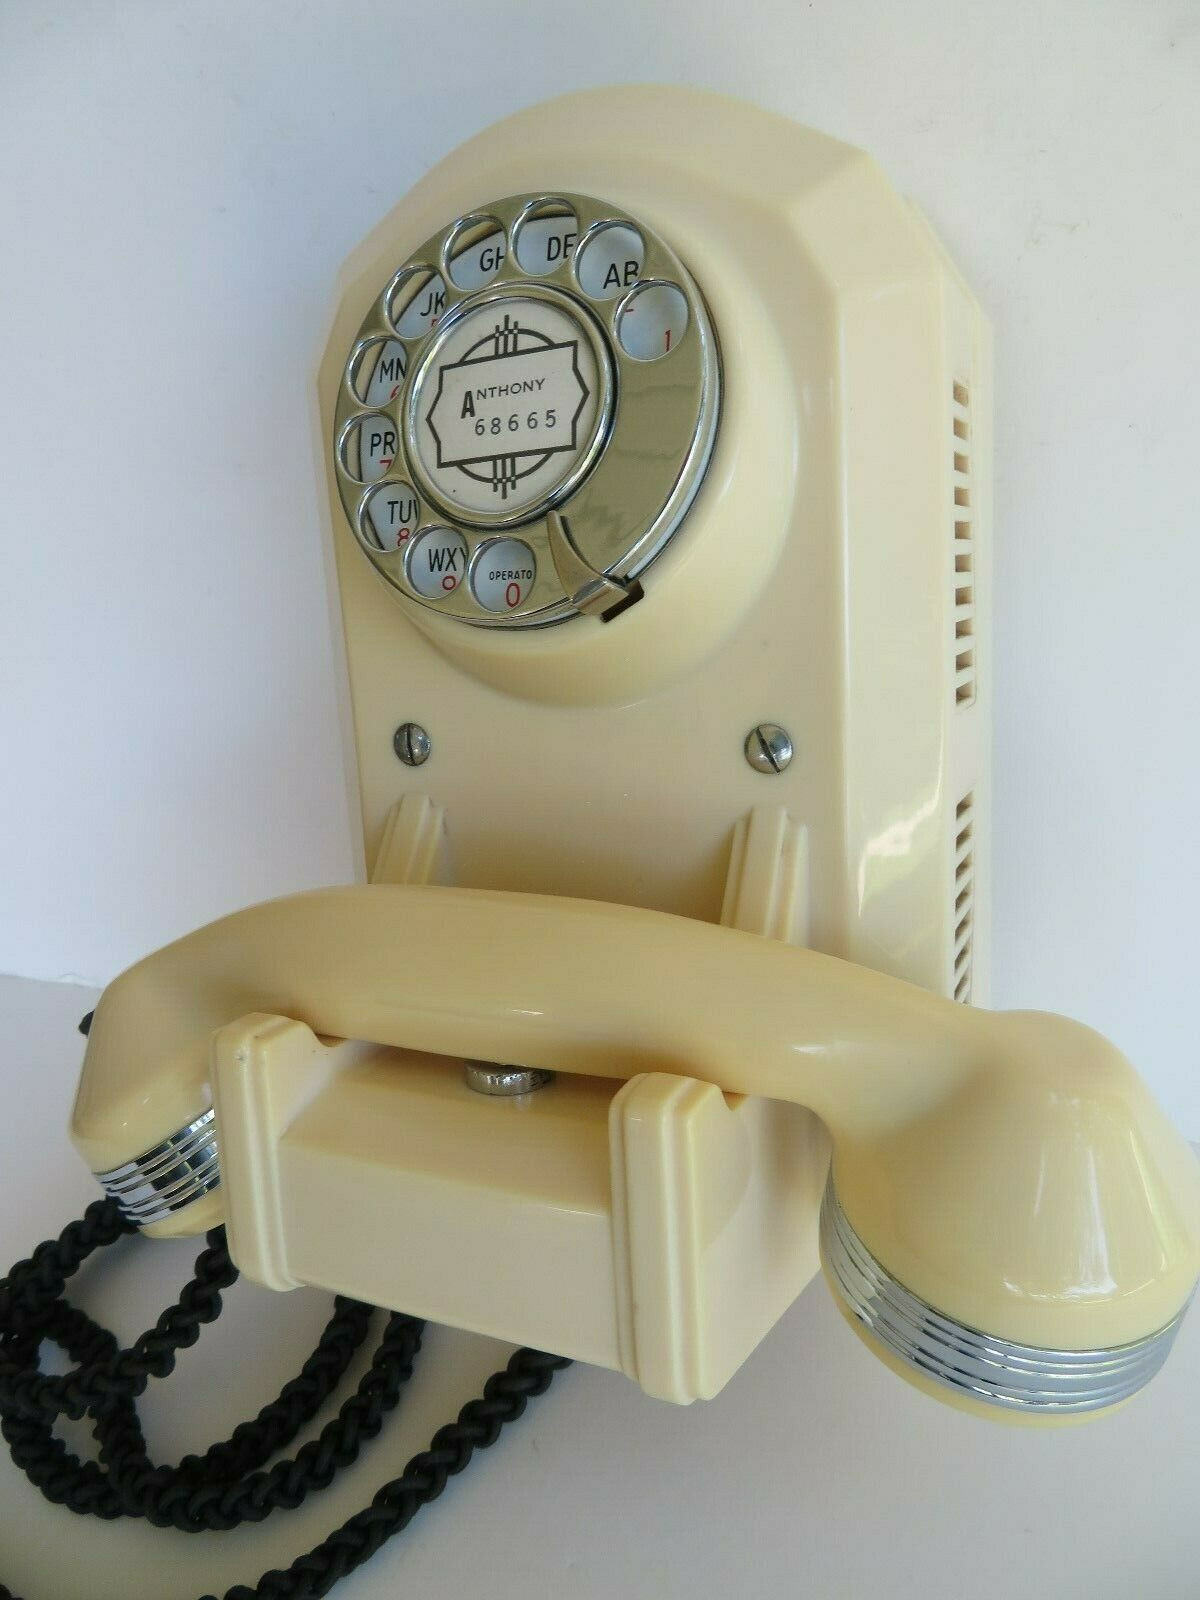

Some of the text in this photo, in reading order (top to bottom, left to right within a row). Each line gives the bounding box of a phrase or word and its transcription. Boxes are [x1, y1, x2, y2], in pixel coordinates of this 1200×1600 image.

[461, 378, 545, 419] ANTHONY
[475, 409, 556, 436] 68665
[370, 430, 395, 457] PR
